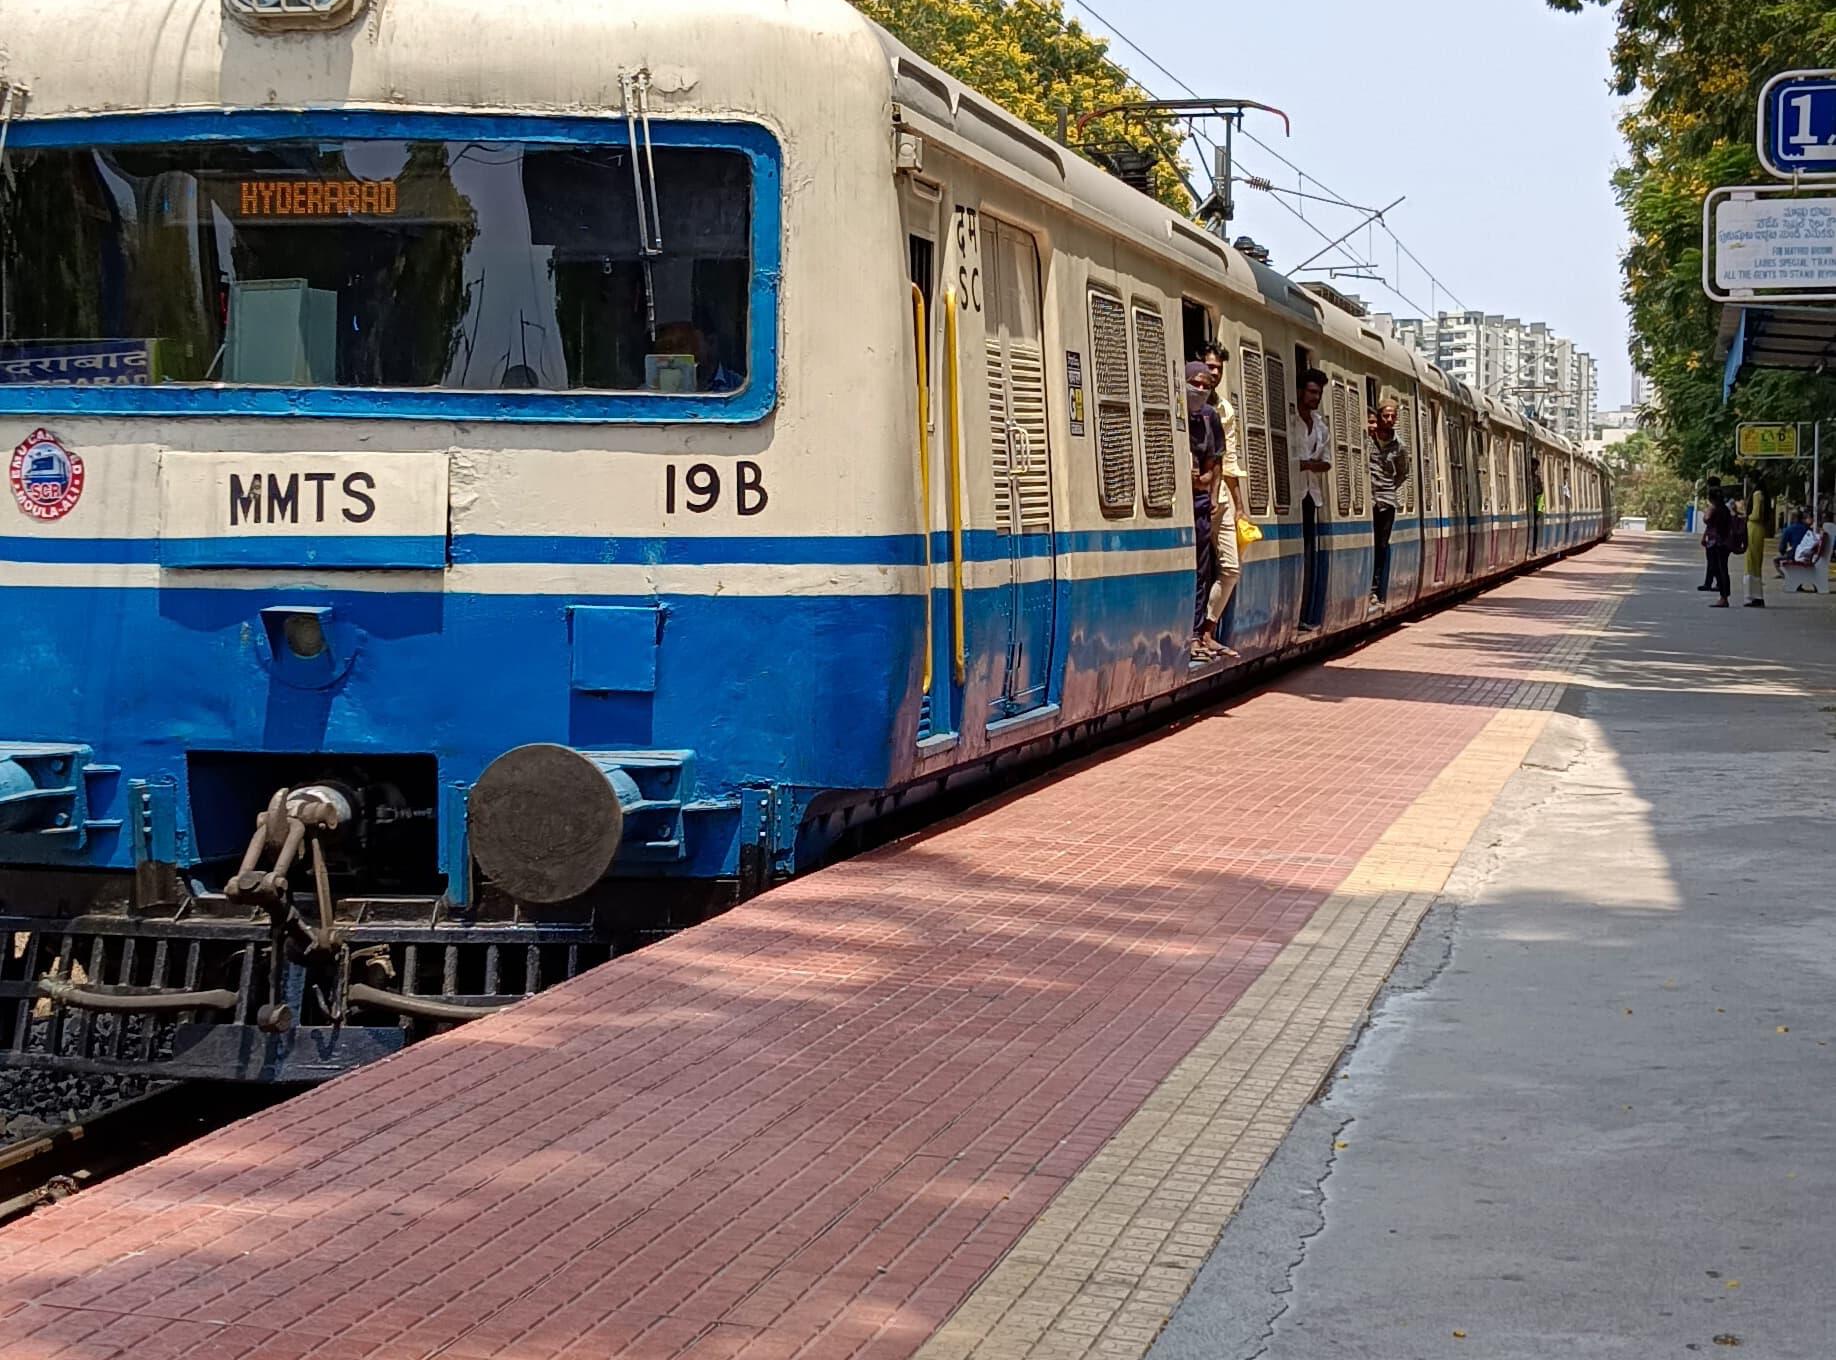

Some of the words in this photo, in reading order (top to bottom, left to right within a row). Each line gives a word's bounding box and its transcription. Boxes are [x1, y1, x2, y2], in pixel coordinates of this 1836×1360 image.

[240, 181, 397, 214] HYDERABAD
[959, 265, 981, 313] SC
[0, 351, 148, 376] दराबाद
[15, 486, 80, 518] MOULA-ALI
[31, 482, 62, 499] SCR
[230, 471, 376, 526] MMTS
